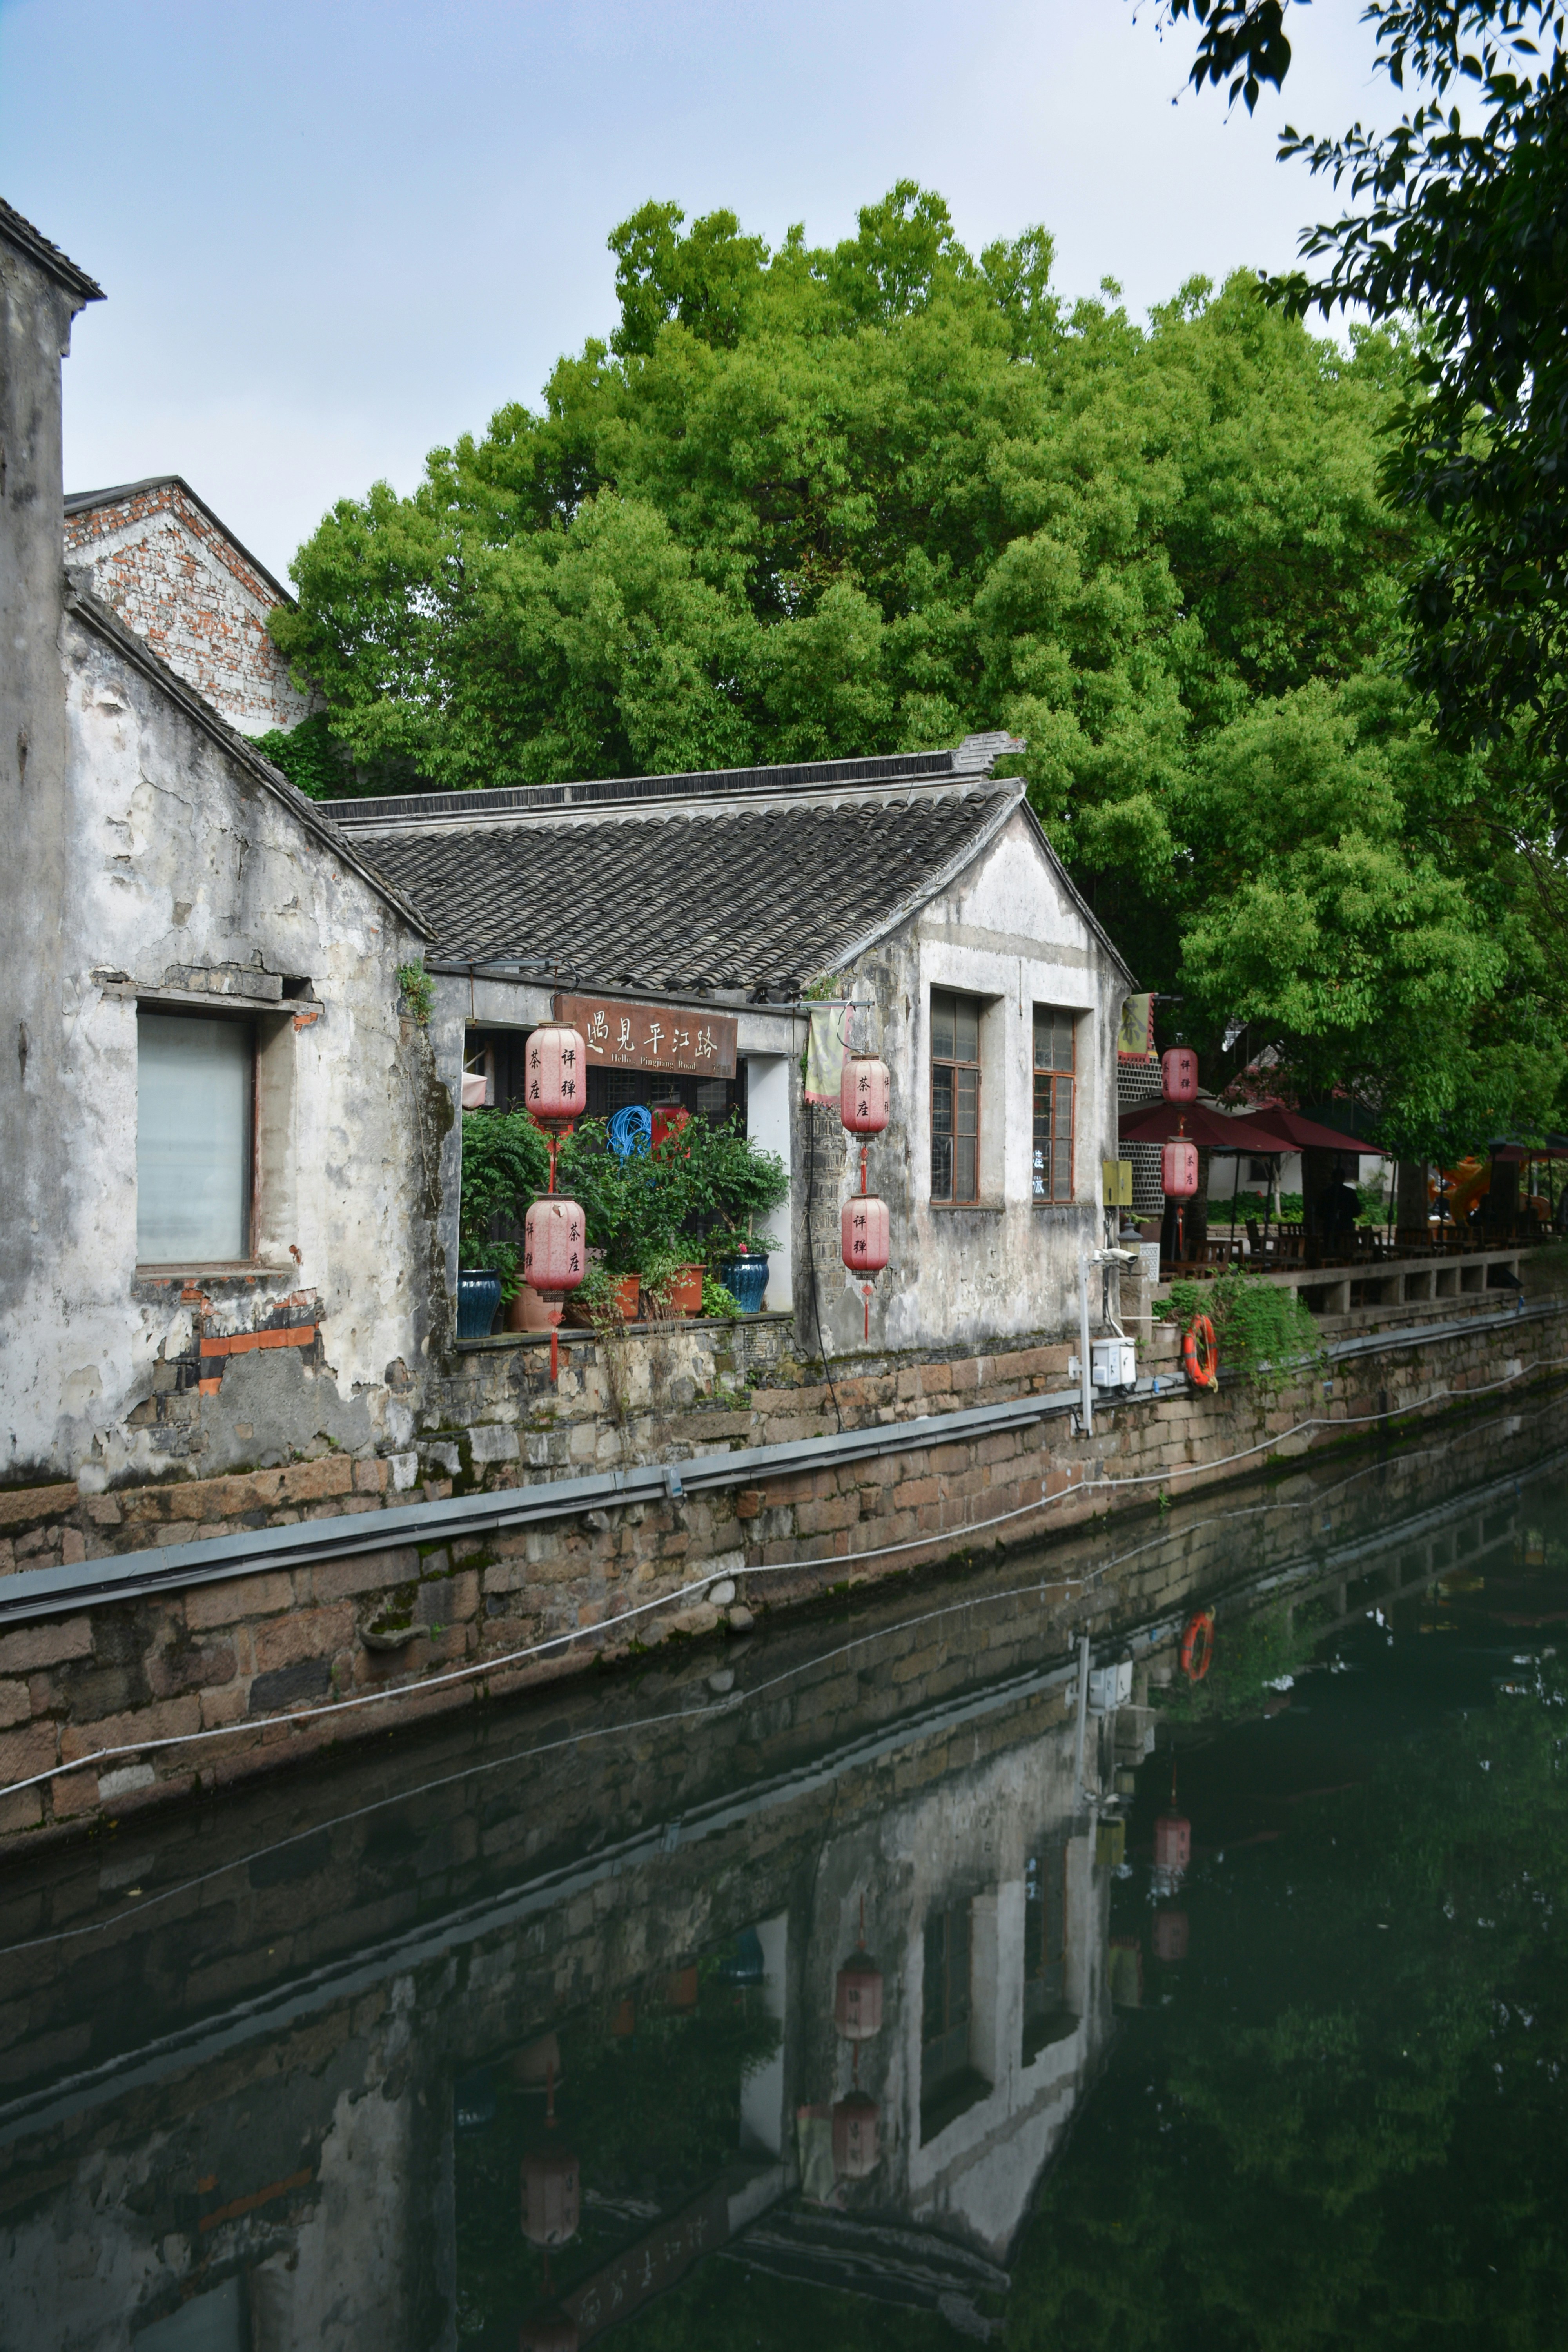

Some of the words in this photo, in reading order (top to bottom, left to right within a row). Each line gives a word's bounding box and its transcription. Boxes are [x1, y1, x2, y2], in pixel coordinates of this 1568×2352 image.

[1121, 998, 1147, 1045] 茶
[529, 1049, 541, 1101] 茶座
[561, 1049, 576, 1100] 评弹
[612, 1053, 631, 1063] Hello
[641, 1056, 674, 1069] Pingjiang
[678, 1060, 696, 1070] Road
[857, 1076, 870, 1117] 茶座
[568, 1222, 580, 1273] 茶座
[853, 1215, 866, 1256] 评弹
